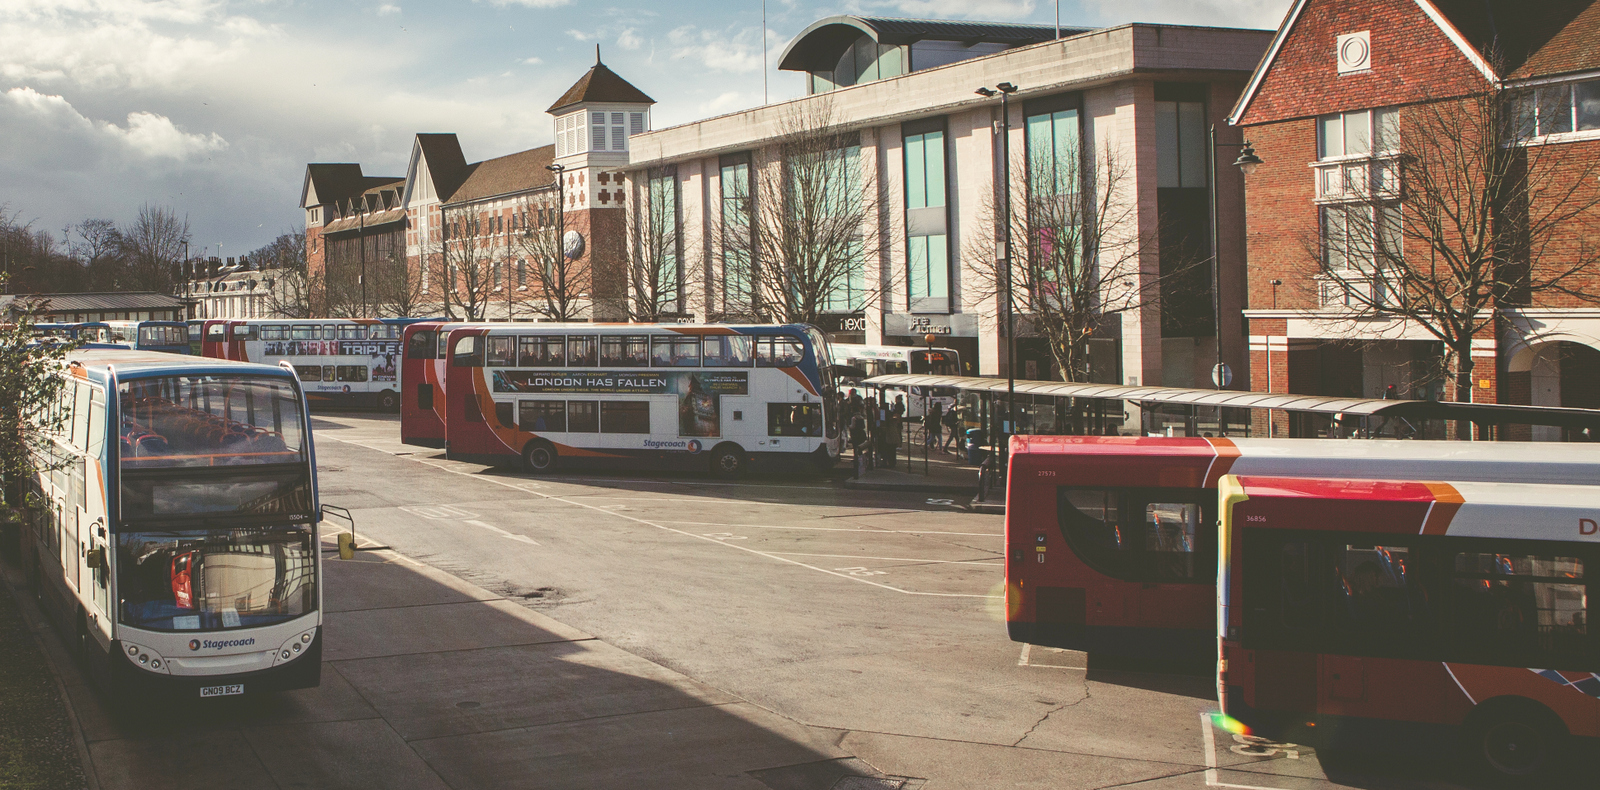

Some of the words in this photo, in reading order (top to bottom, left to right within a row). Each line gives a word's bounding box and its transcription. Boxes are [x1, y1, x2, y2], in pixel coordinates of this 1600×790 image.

[840, 317, 866, 331] next
[342, 345, 395, 355] TRIPLE
[528, 378, 582, 387] LONDON
[586, 378, 613, 387] HAS
[617, 378, 667, 388] FALLEN
[643, 439, 686, 449] Stagecoach
[1246, 515, 1267, 523] 36856
[1579, 518, 1600, 535] D
[203, 637, 255, 651] Stagecoach
[202, 686, 224, 696] GN09
[225, 684, 241, 695] BCZ
